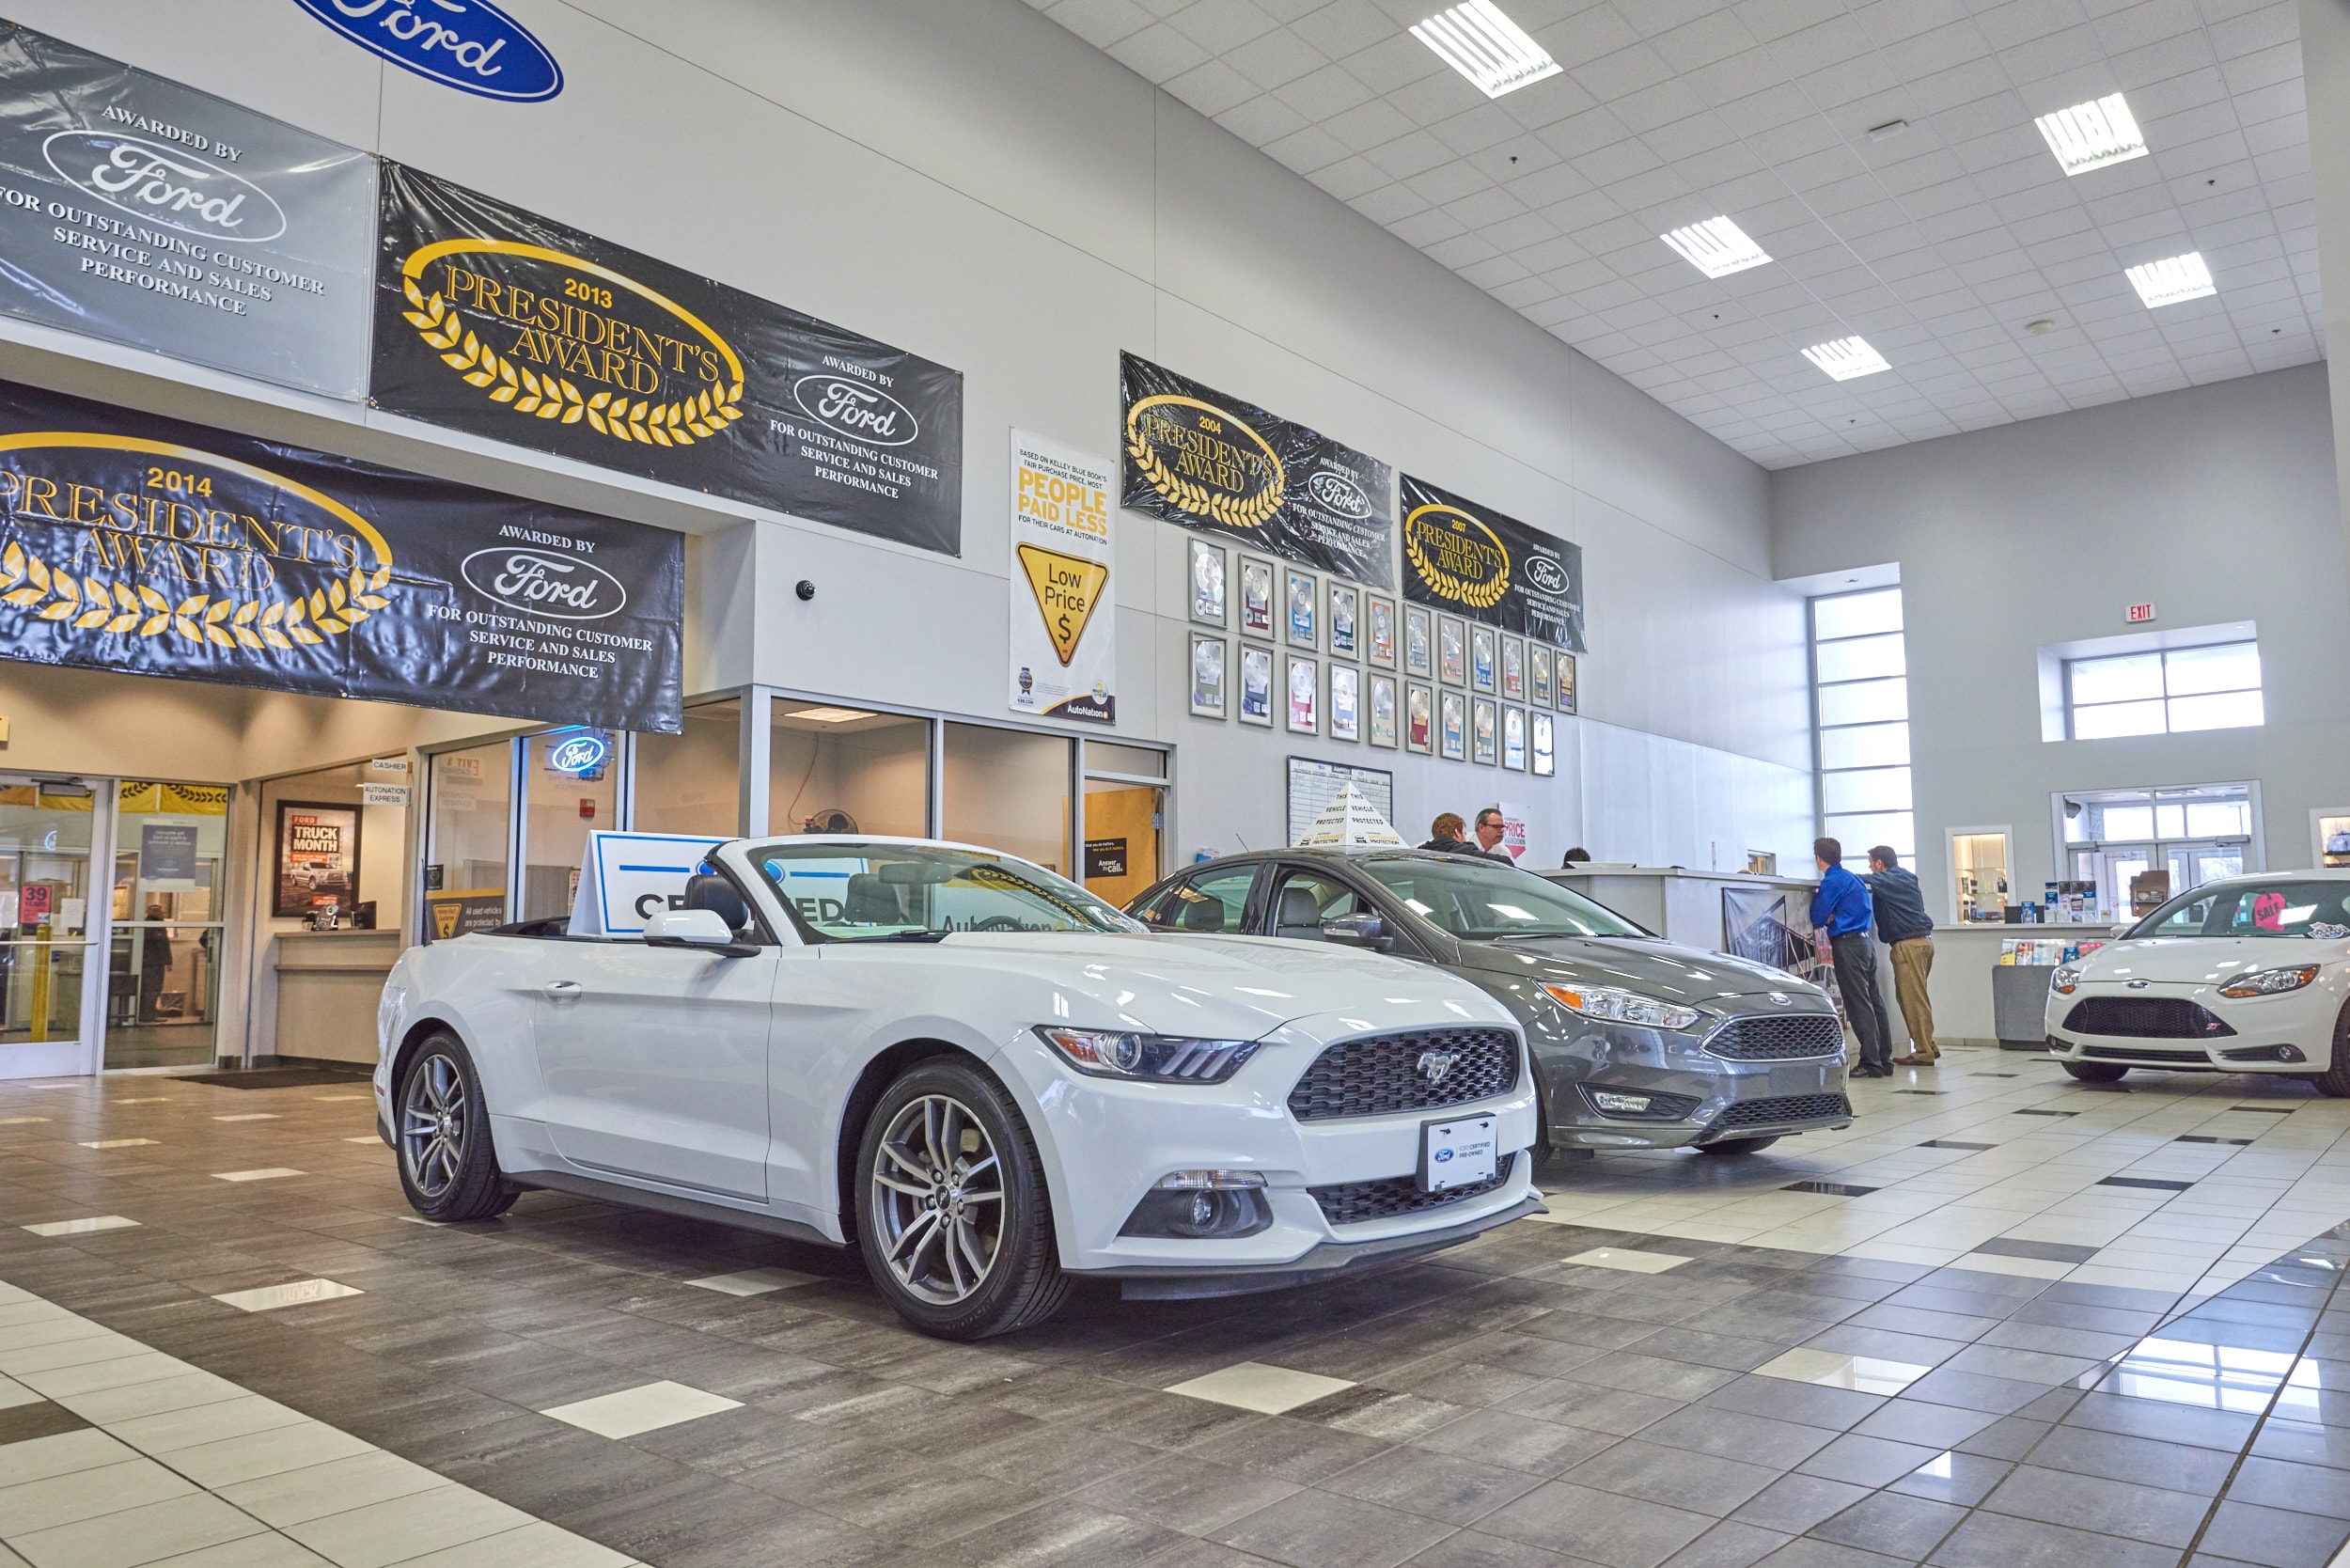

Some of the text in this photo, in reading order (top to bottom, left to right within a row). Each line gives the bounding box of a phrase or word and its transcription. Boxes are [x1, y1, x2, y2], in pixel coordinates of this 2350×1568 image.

[102, 104, 243, 164] AWARDED BY
[92, 144, 243, 227] Ford
[48, 201, 208, 262] OUTSTANDING
[213, 250, 325, 296] CUSTOMER
[54, 227, 272, 303] SERVICE AND SALES
[81, 257, 247, 316] PERFORMANCE
[565, 278, 613, 309] 2013
[445, 264, 720, 383] PRESIDENT'S
[509, 326, 659, 395] AWARD
[822, 355, 894, 387] AWARDED BY
[819, 383, 897, 438] Ford
[1199, 416, 1221, 434] 2004
[770, 419, 938, 479] FOR OUTSTANDING CUSTOMER
[1146, 414, 1273, 481] PRESIDENT'S
[801, 445, 912, 487] SERVICE AND SALES
[1020, 449, 1039, 461] BASED
[1050, 460, 1071, 470] KELLEY
[1073, 466, 1086, 476] BLUE
[1088, 471, 1107, 482] BOOK'S
[1025, 460, 1036, 469] FAIR
[1039, 464, 1068, 478] PURCHASE
[1070, 475, 1087, 485] PRICE,
[1175, 450, 1244, 493] AWARD
[1320, 457, 1357, 482] AWARDED BY
[148, 467, 212, 497] 2014
[815, 466, 899, 499] PERFORMANCE
[1019, 466, 1107, 517] PEOPLE
[1322, 476, 1364, 513] Ford
[1019, 493, 1107, 536] PAID LESS
[1293, 503, 1386, 541] FOR OUTSTANDING CUSTOMER
[1452, 520, 1466, 532] 2007
[499, 525, 596, 553] AWARDED BY
[1033, 519, 1048, 528] THEIR
[1050, 525, 1064, 534] CARS
[1074, 531, 1107, 545] AUTONATION
[1311, 523, 1371, 549] SERVICE AND SALES
[1416, 521, 1501, 568] PRESIDENT'S
[66, 525, 275, 592] AWARD
[1318, 535, 1365, 558] PERFORMANCE
[1533, 543, 1554, 557] AWARDED
[1048, 563, 1081, 588] Low
[1437, 549, 1483, 579] AWARD
[1534, 560, 1560, 588] Ford
[494, 554, 598, 610] Ford
[1044, 586, 1085, 613] Price
[1515, 585, 1580, 613] FOR OUTSTANDING CUSTOMER
[1527, 598, 1545, 611] SERVICE
[1556, 608, 1570, 619] SALES
[2131, 604, 2151, 619] EXIT
[429, 604, 652, 652] FOR OUTSTANDING CUSTOMER
[1058, 613, 1072, 644] $
[1532, 610, 1566, 626] PERFORMANCE
[469, 630, 616, 665] SERVICE AND SALES
[487, 651, 598, 679] PERFORMANCE
[1068, 705, 1104, 718] AutoNation
[374, 761, 406, 770] CASHIER
[562, 742, 594, 767] Ford
[365, 786, 406, 794] AUTONATION
[294, 826, 337, 839] TRUCK
[1504, 822, 1525, 838] PRICE
[293, 839, 337, 852] MONTH
[25, 887, 47, 901] 39
[473, 919, 494, 928] protected
[495, 918, 501, 927] by
[484, 906, 502, 915] vehicles
[2257, 902, 2280, 920] SALE
[1438, 1150, 1450, 1161] Ford
[1459, 1150, 1483, 1158] PRE-OWNED
[1470, 1141, 1490, 1150] CERTIFIED
